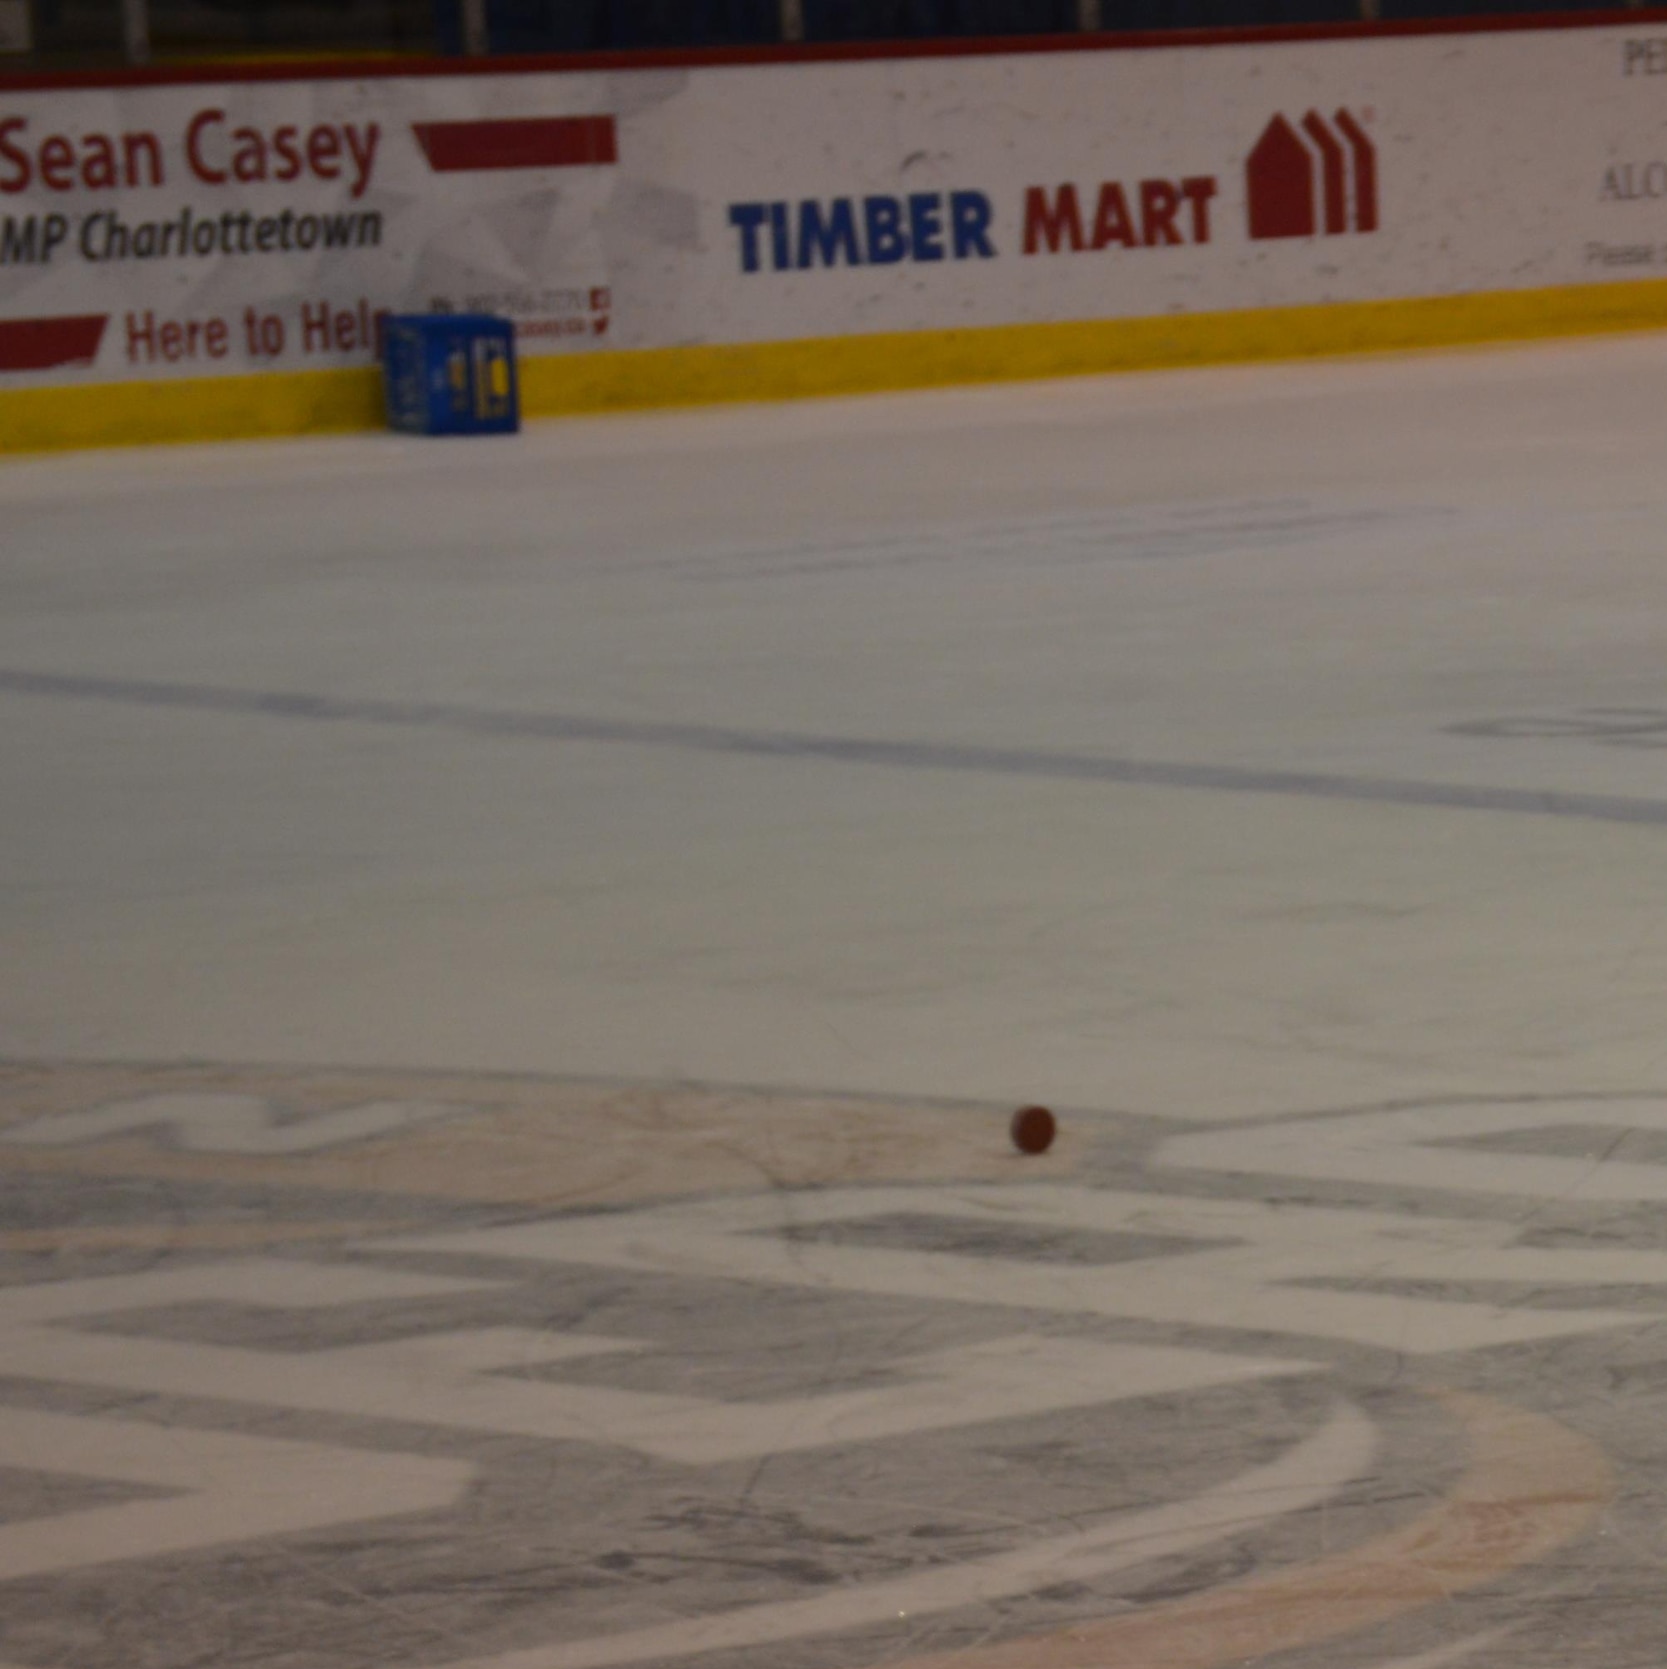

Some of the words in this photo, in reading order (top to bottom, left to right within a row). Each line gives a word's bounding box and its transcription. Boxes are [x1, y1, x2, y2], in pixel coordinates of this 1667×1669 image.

[0, 117, 163, 194] Sean
[186, 109, 381, 198] Casey
[0, 214, 69, 265] MP
[79, 206, 383, 263] Charlottetown
[729, 190, 996, 273] TIMBER
[1022, 176, 1218, 256] MART
[125, 310, 229, 364] Here
[244, 304, 285, 357] to
